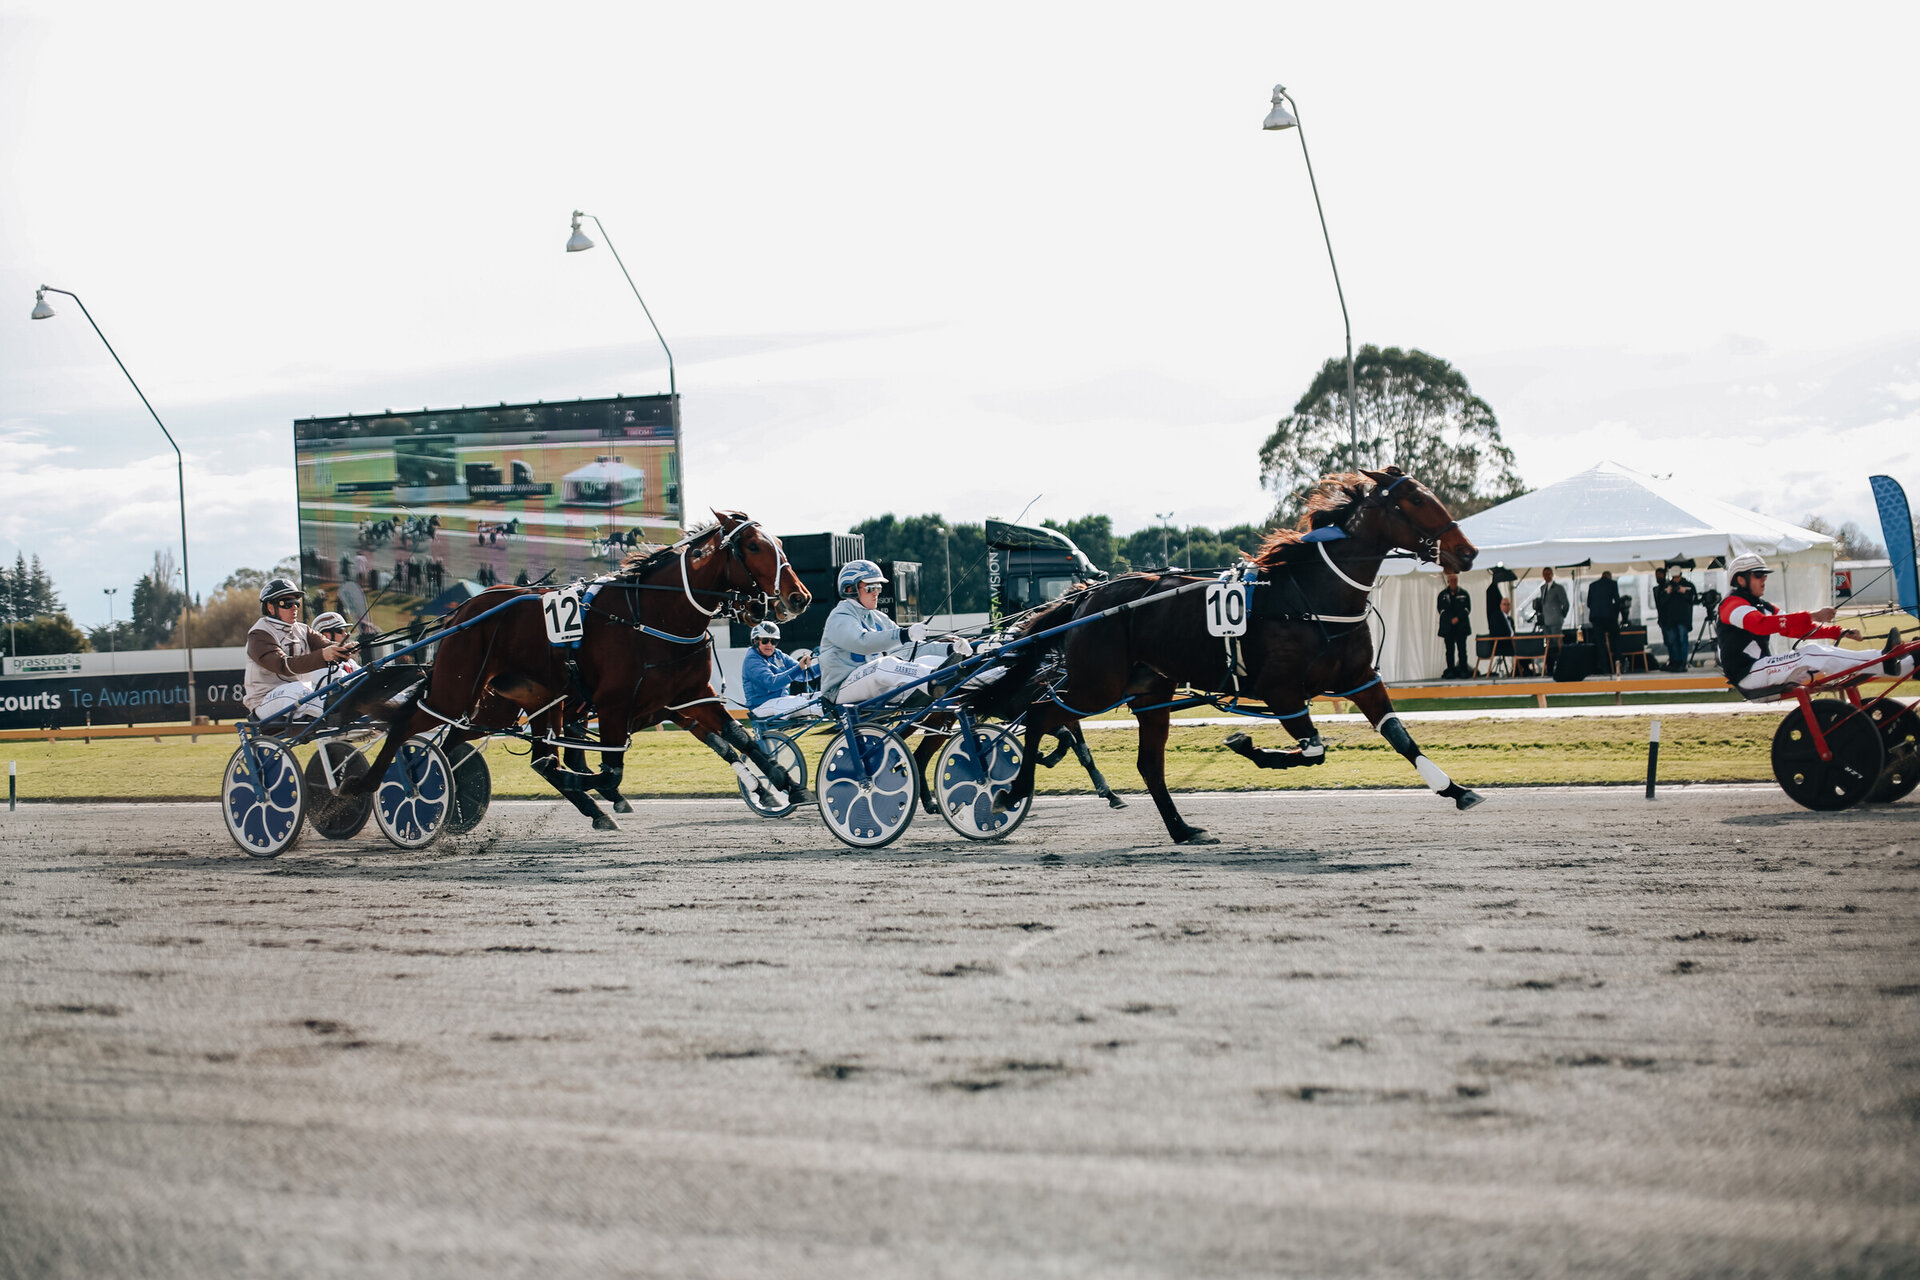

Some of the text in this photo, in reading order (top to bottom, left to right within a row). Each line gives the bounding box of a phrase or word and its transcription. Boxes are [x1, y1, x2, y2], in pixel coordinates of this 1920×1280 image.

[545, 597, 581, 633] 12
[1208, 590, 1244, 625] 10
[69, 688, 93, 708] Te
[208, 685, 228, 702] 07
